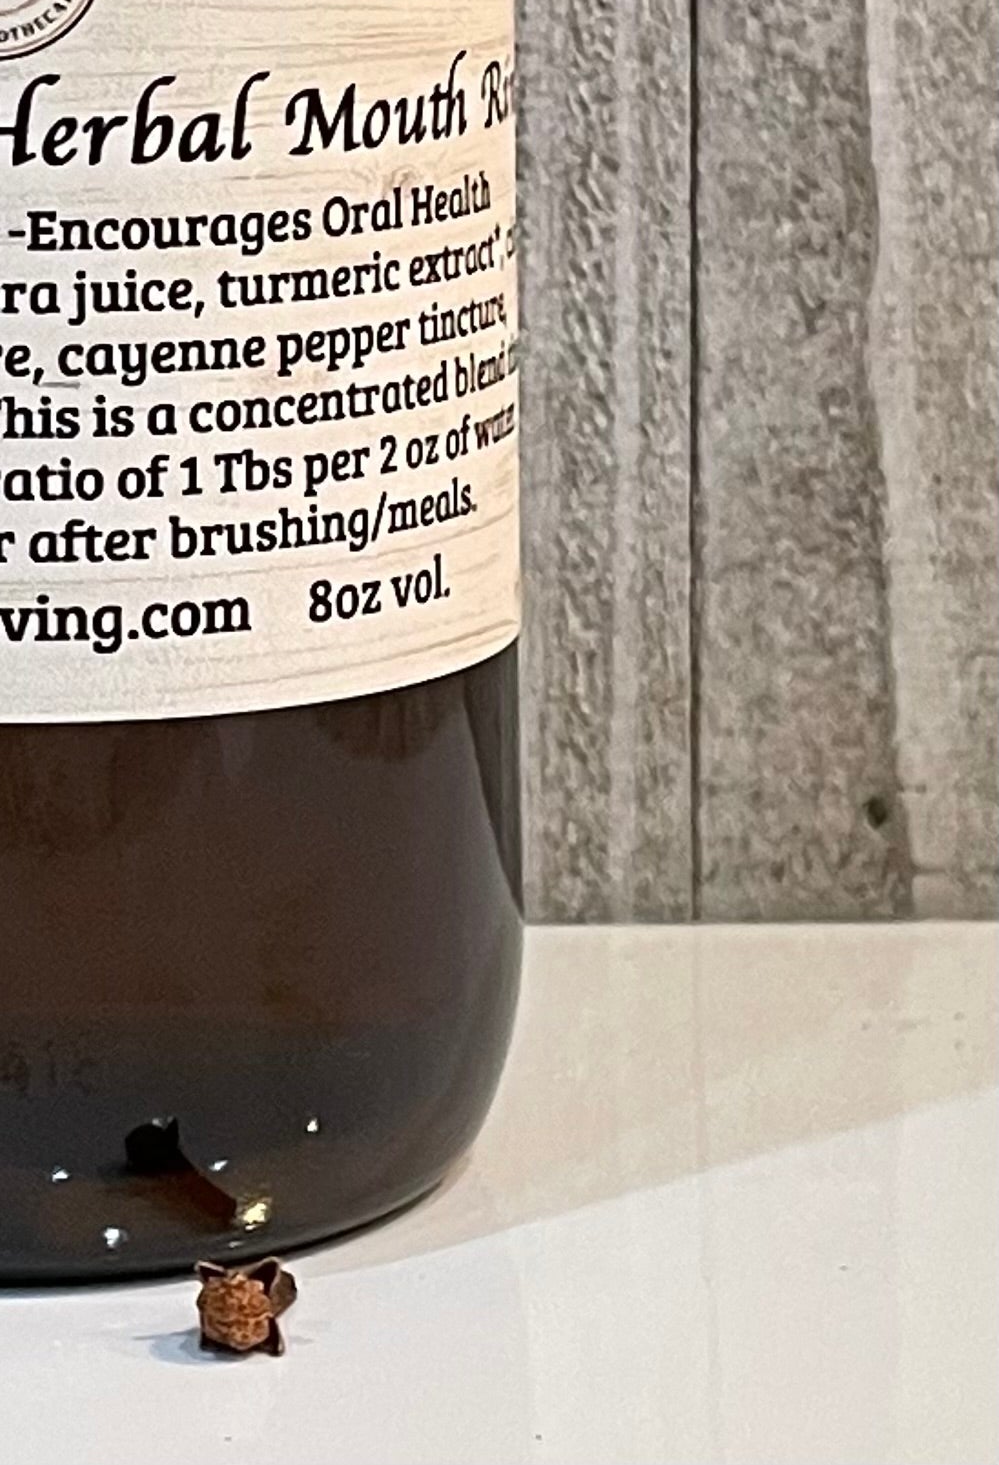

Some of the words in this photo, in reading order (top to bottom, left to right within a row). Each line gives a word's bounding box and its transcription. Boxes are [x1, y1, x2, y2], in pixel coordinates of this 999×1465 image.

[286, 50, 468, 155] Mouth
[323, 187, 403, 236] Oral
[411, 171, 491, 227] Health
[69, 270, 205, 325] juice,
[218, 251, 400, 308] turmeric
[58, 334, 266, 387] cayenne
[276, 319, 410, 377] pepper
[93, 395, 134, 438] is
[147, 403, 177, 436] a
[190, 360, 448, 434] concentrated
[117, 454, 171, 500] of
[179, 456, 201, 496] 1
[214, 449, 292, 492] Tbs
[303, 447, 370, 497] per
[380, 435, 398, 474] 2
[406, 435, 439, 469] oz
[446, 413, 471, 460] of
[29, 520, 157, 563] after
[169, 477, 478, 558] brushing/meals.
[309, 580, 382, 623] 8oz
[391, 553, 451, 608] vol.
